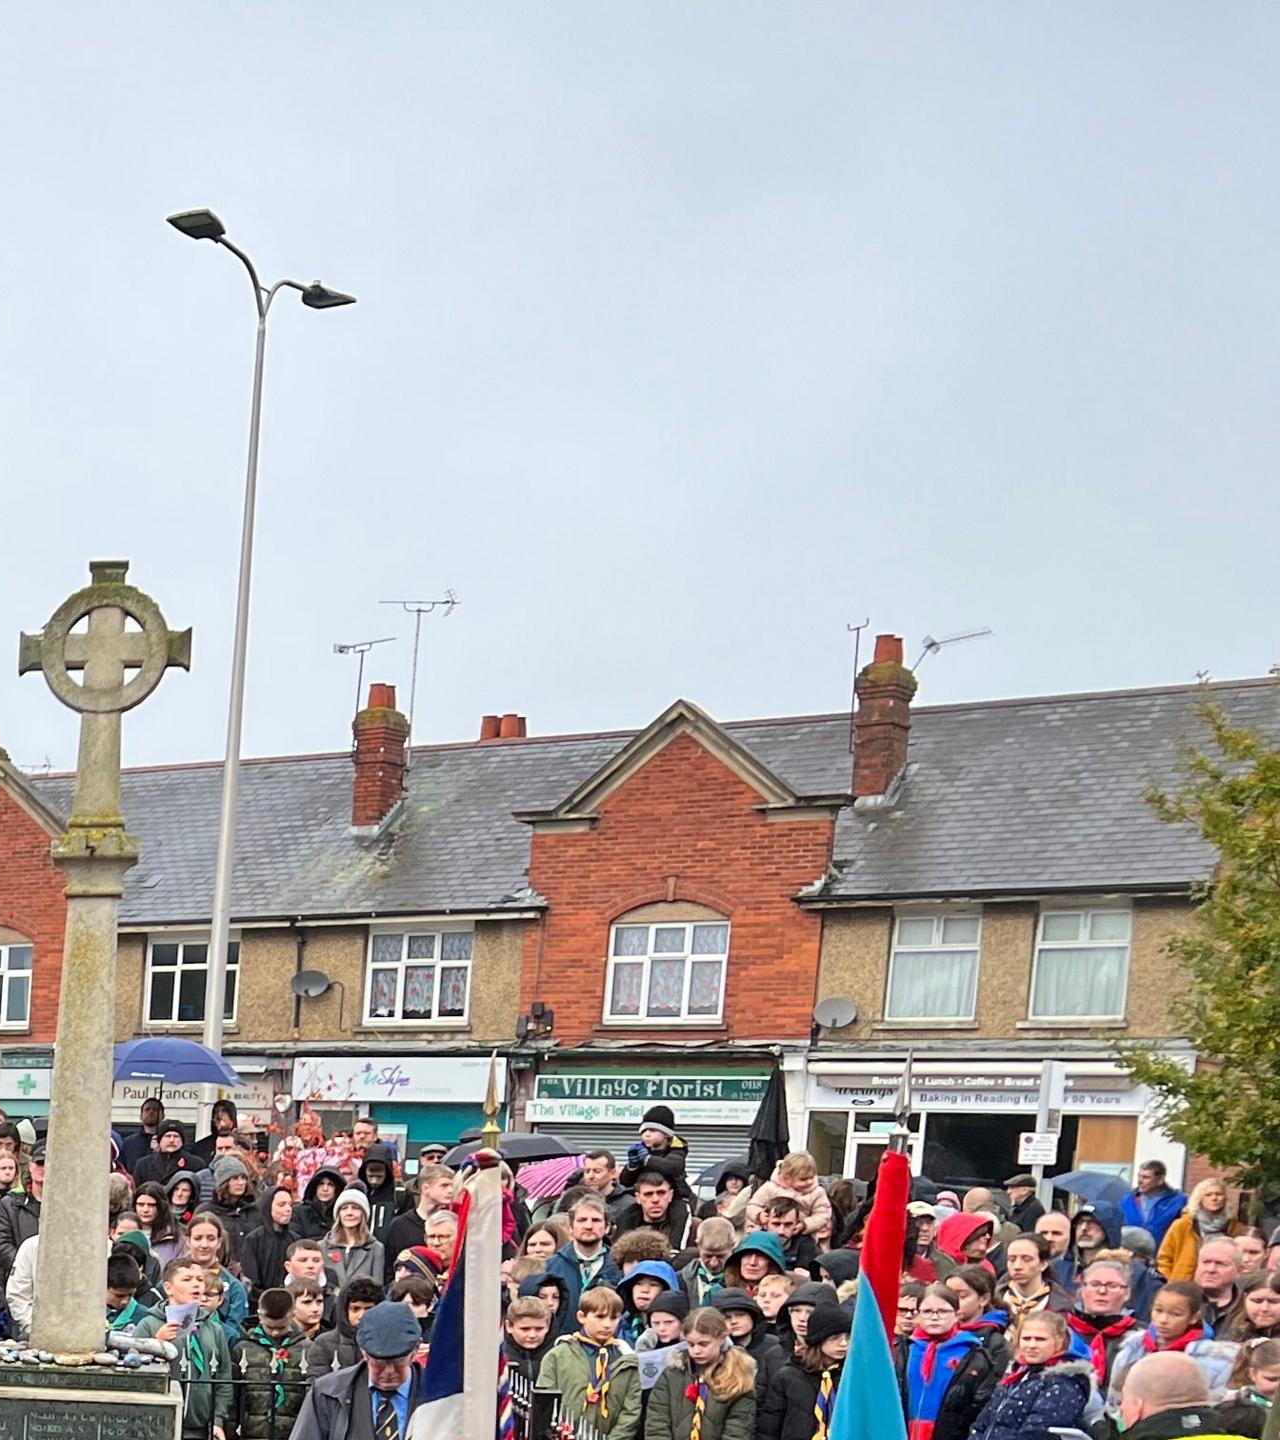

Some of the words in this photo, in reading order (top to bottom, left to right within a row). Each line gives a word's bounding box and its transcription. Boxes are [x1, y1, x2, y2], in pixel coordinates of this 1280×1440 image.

[925, 1076, 954, 1086] Lunch
[964, 1076, 995, 1086] Coffee
[1004, 1077, 1034, 1086] Bread
[123, 1086, 149, 1099] Paul
[154, 1087, 199, 1099] Francis
[562, 1078, 640, 1097] Village
[644, 1078, 724, 1098] Florist
[920, 1093, 957, 1104] Baking
[961, 1094, 971, 1103] in
[975, 1094, 1020, 1105] Reading
[1090, 1095, 1121, 1104] Years
[532, 1104, 553, 1116] The
[560, 1104, 599, 1120] Village
